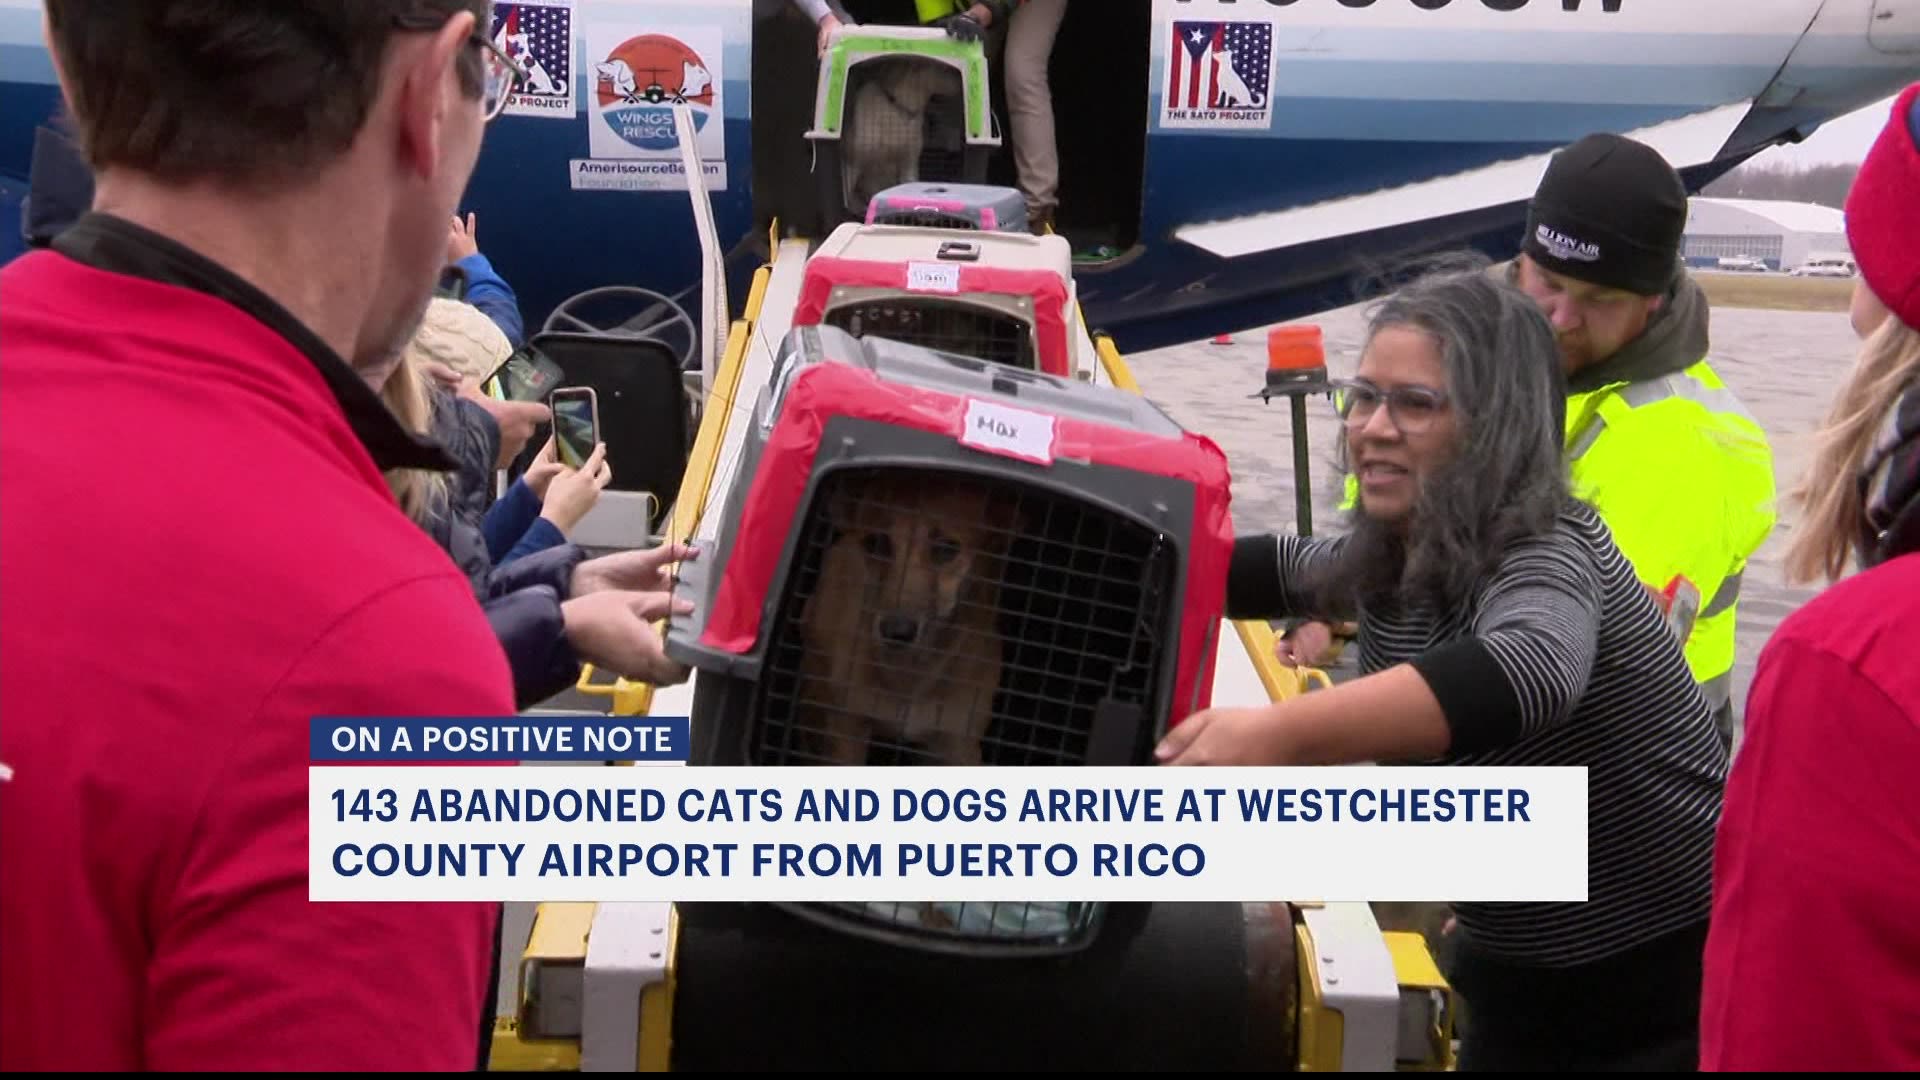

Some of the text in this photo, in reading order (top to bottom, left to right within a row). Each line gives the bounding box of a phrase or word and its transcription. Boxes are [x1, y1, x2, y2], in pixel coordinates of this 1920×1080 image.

[520, 96, 569, 108] PROJECT
[616, 110, 673, 124] WINGS
[1168, 111, 1187, 119] THE
[1219, 111, 1267, 120] PROJECT
[623, 126, 677, 139] RESCU
[579, 161, 719, 175] AmerisourceBeen
[1578, 242, 1600, 256] AIR
[977, 415, 1019, 439] Max
